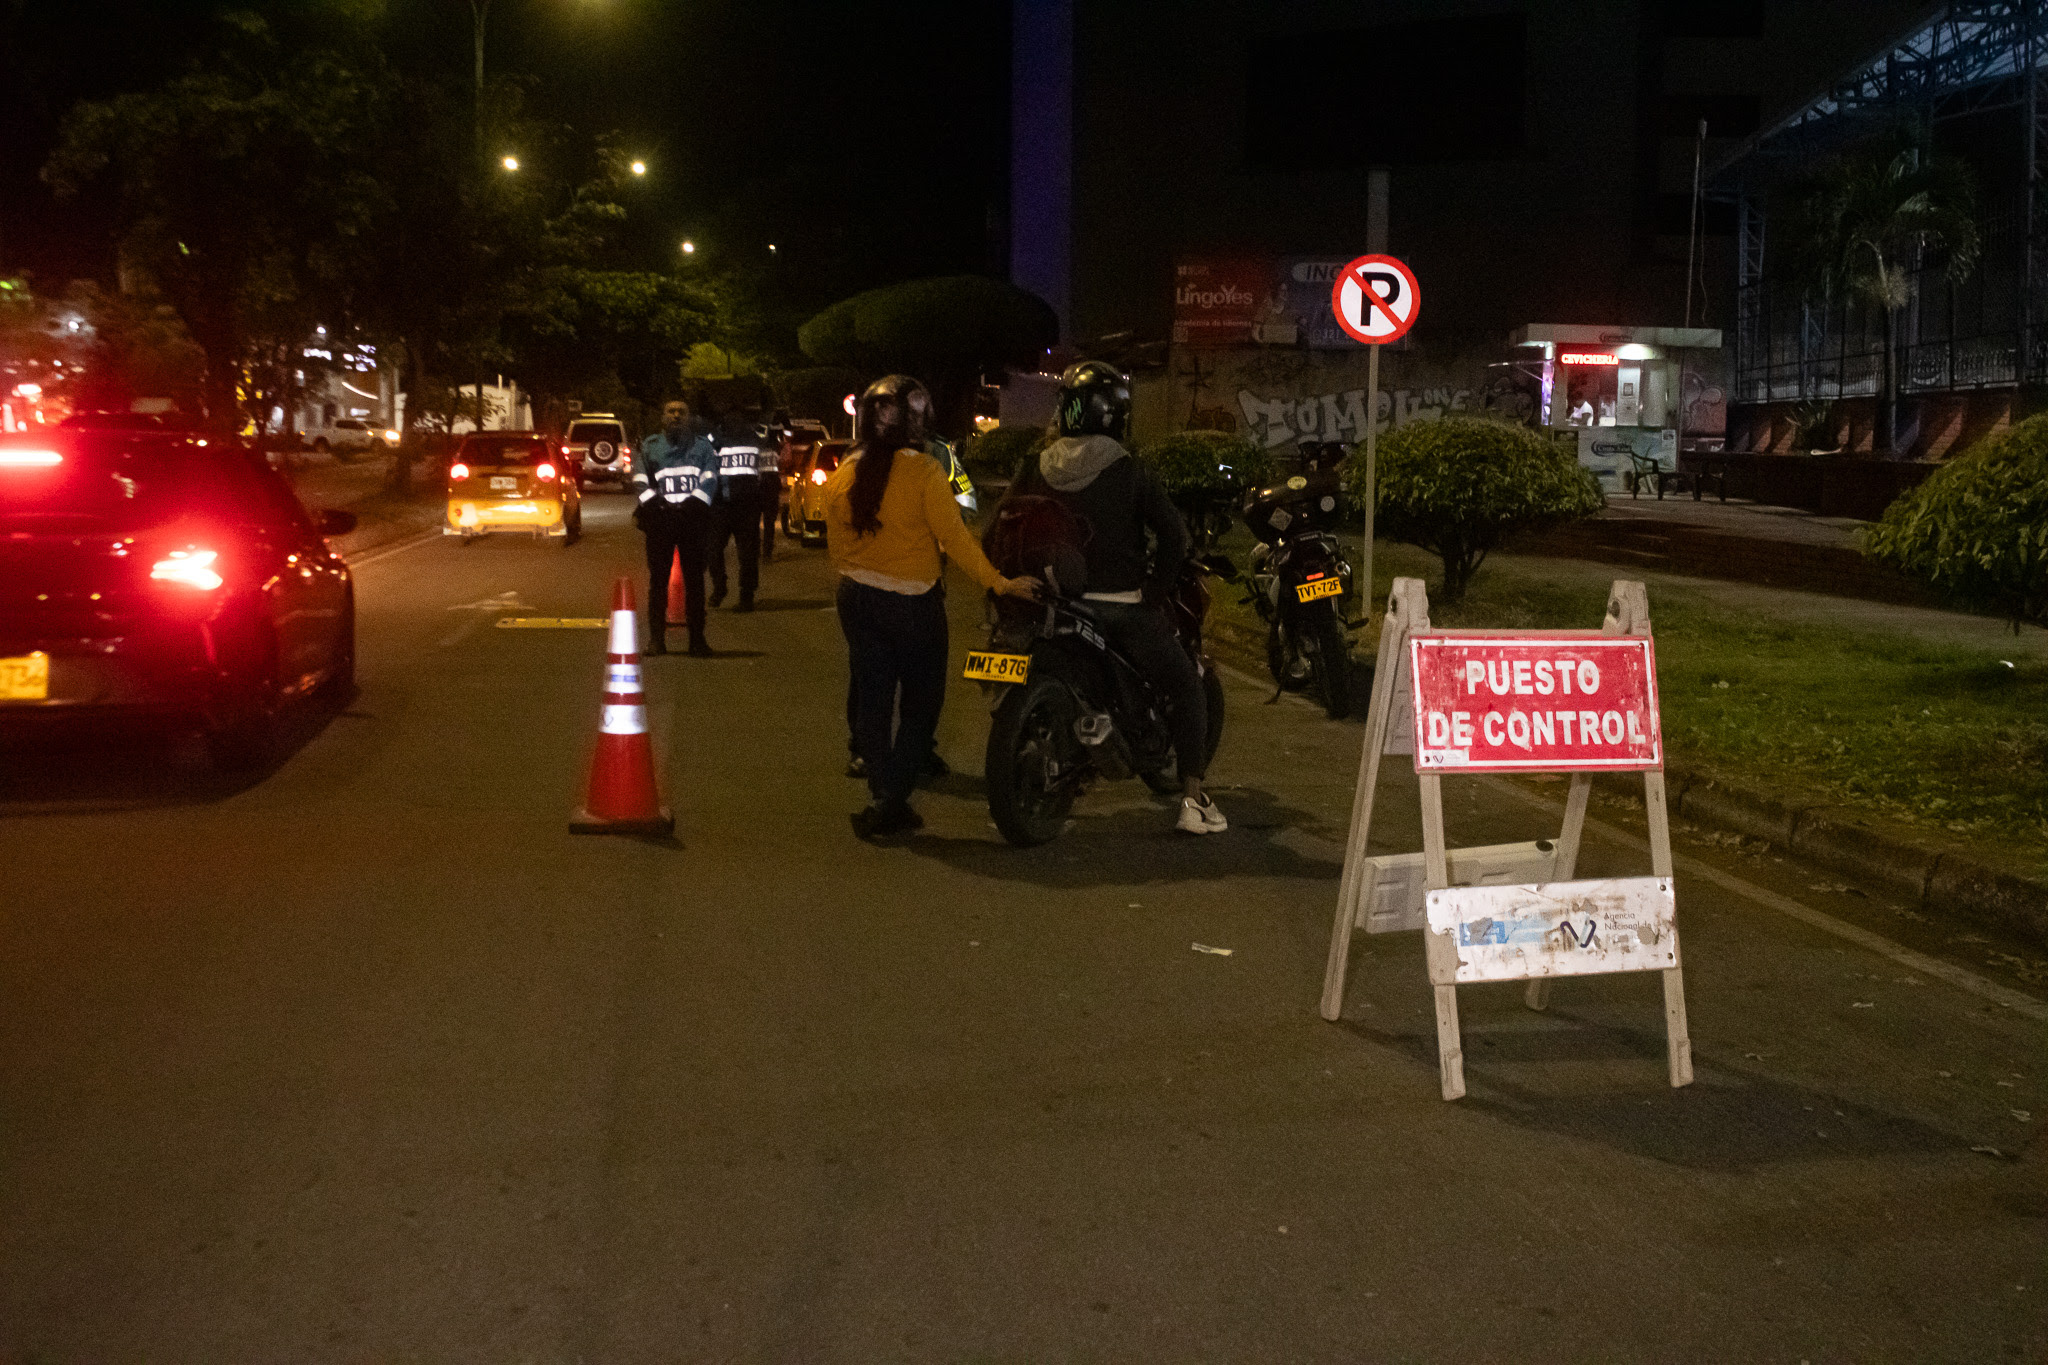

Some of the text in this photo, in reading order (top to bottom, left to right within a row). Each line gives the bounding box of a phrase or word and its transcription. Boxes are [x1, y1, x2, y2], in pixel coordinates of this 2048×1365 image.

[1176, 283, 1253, 309] LingoYes
[1465, 659, 1600, 695] PUESTO
[1428, 709, 1647, 748] DE CONTROL
[1603, 912, 1636, 922] Agencia
